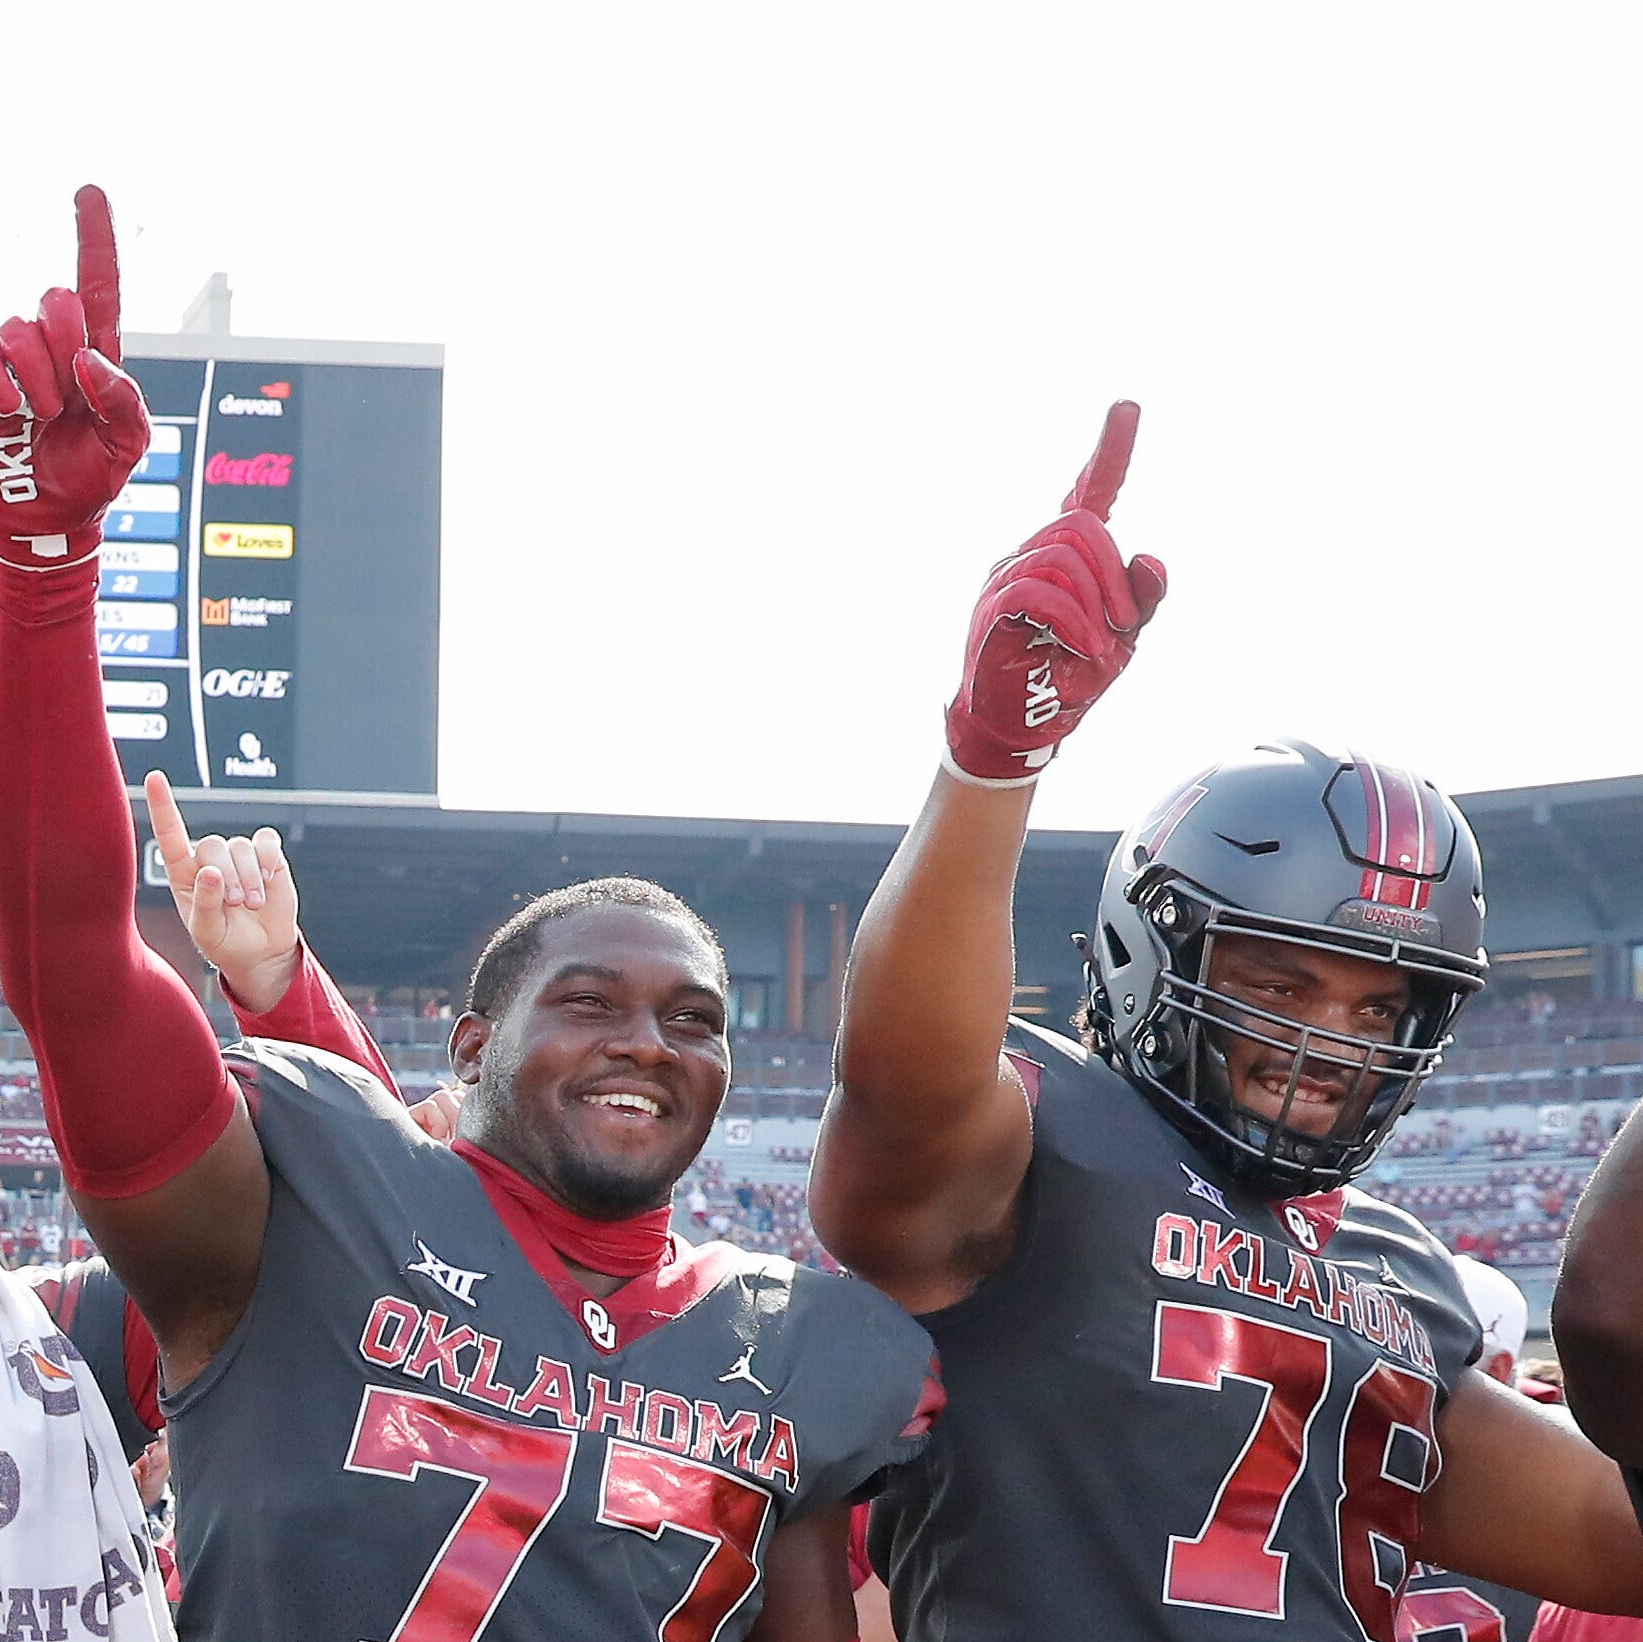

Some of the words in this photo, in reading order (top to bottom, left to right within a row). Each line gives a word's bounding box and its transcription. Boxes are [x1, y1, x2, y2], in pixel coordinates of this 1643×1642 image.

[218, 393, 284, 416] devon
[1363, 906, 1424, 930] UNITY
[1284, 1205, 1320, 1254] OU
[1150, 1210, 1437, 1376] OKLAHOMA
[582, 1298, 616, 1350] OU
[358, 1294, 800, 1494] OKLAHOMA
